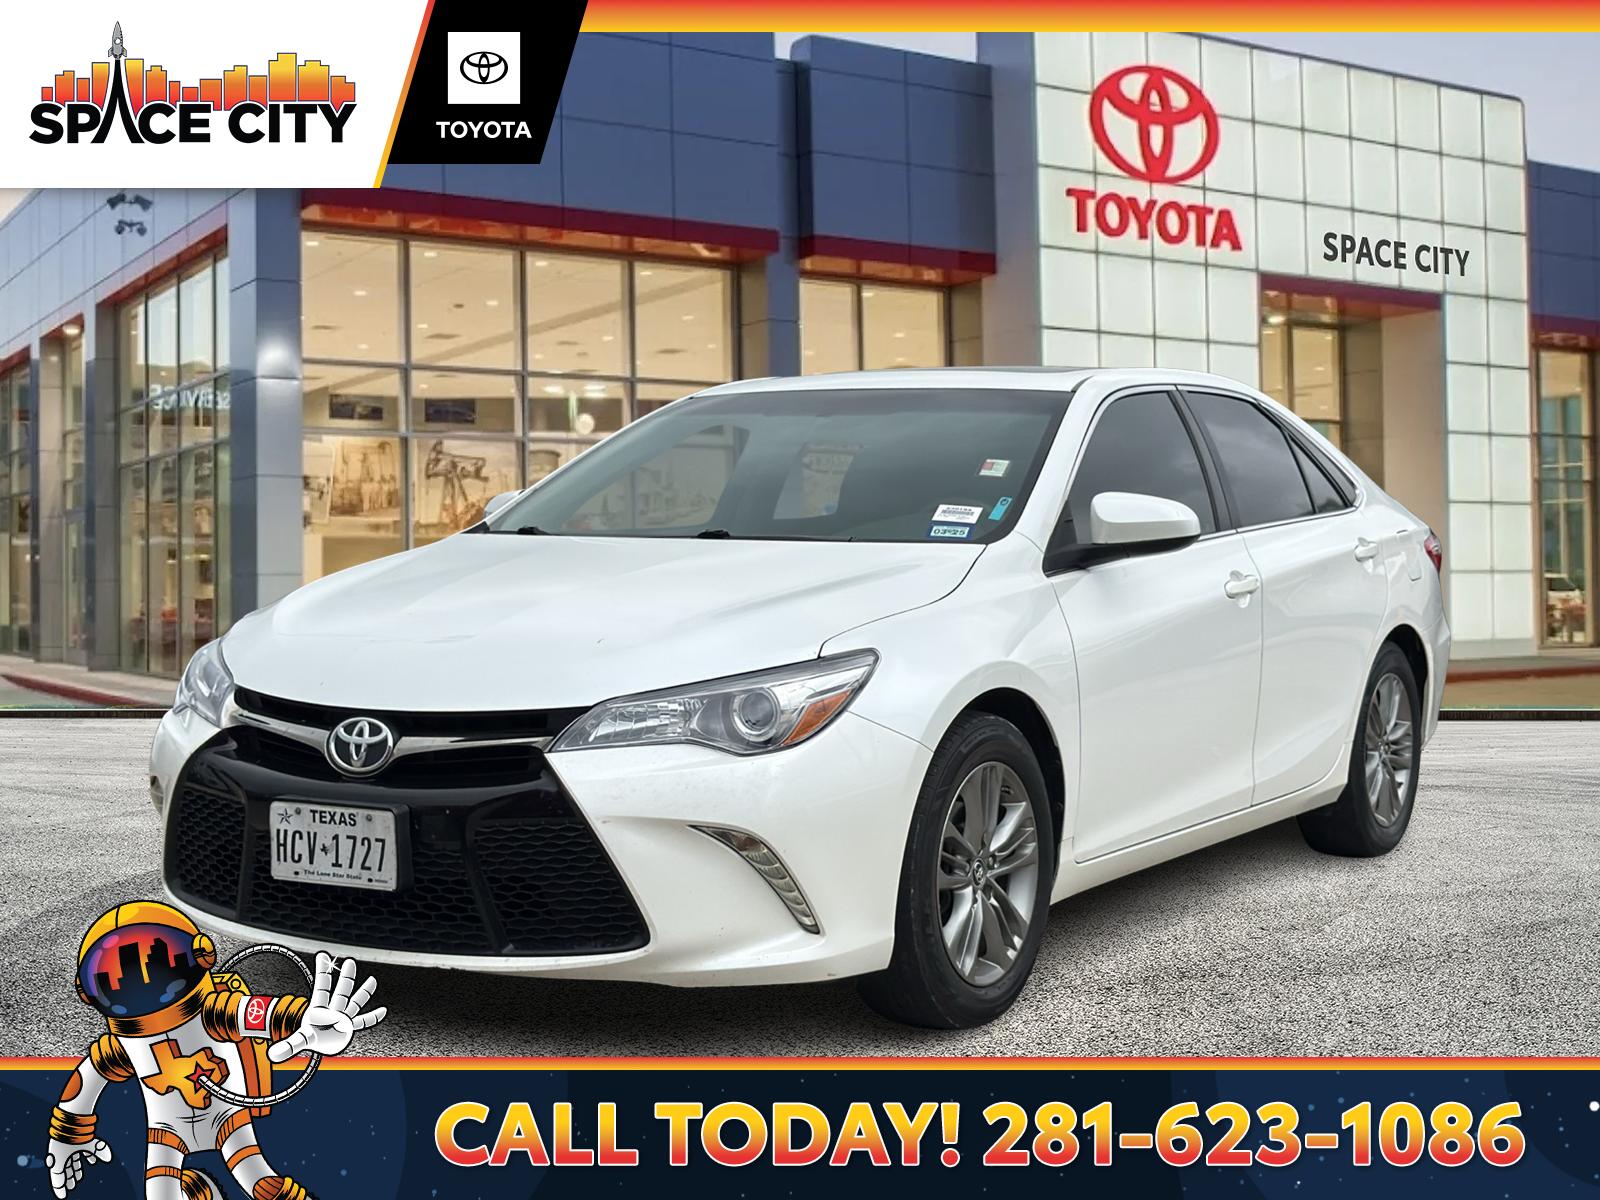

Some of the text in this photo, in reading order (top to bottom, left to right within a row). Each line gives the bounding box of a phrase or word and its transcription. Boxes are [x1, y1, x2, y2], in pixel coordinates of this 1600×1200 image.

[1067, 188, 1242, 251] TOYOTA
[1323, 232, 1470, 277] SPACE CITY
[310, 809, 357, 827] TEXAS
